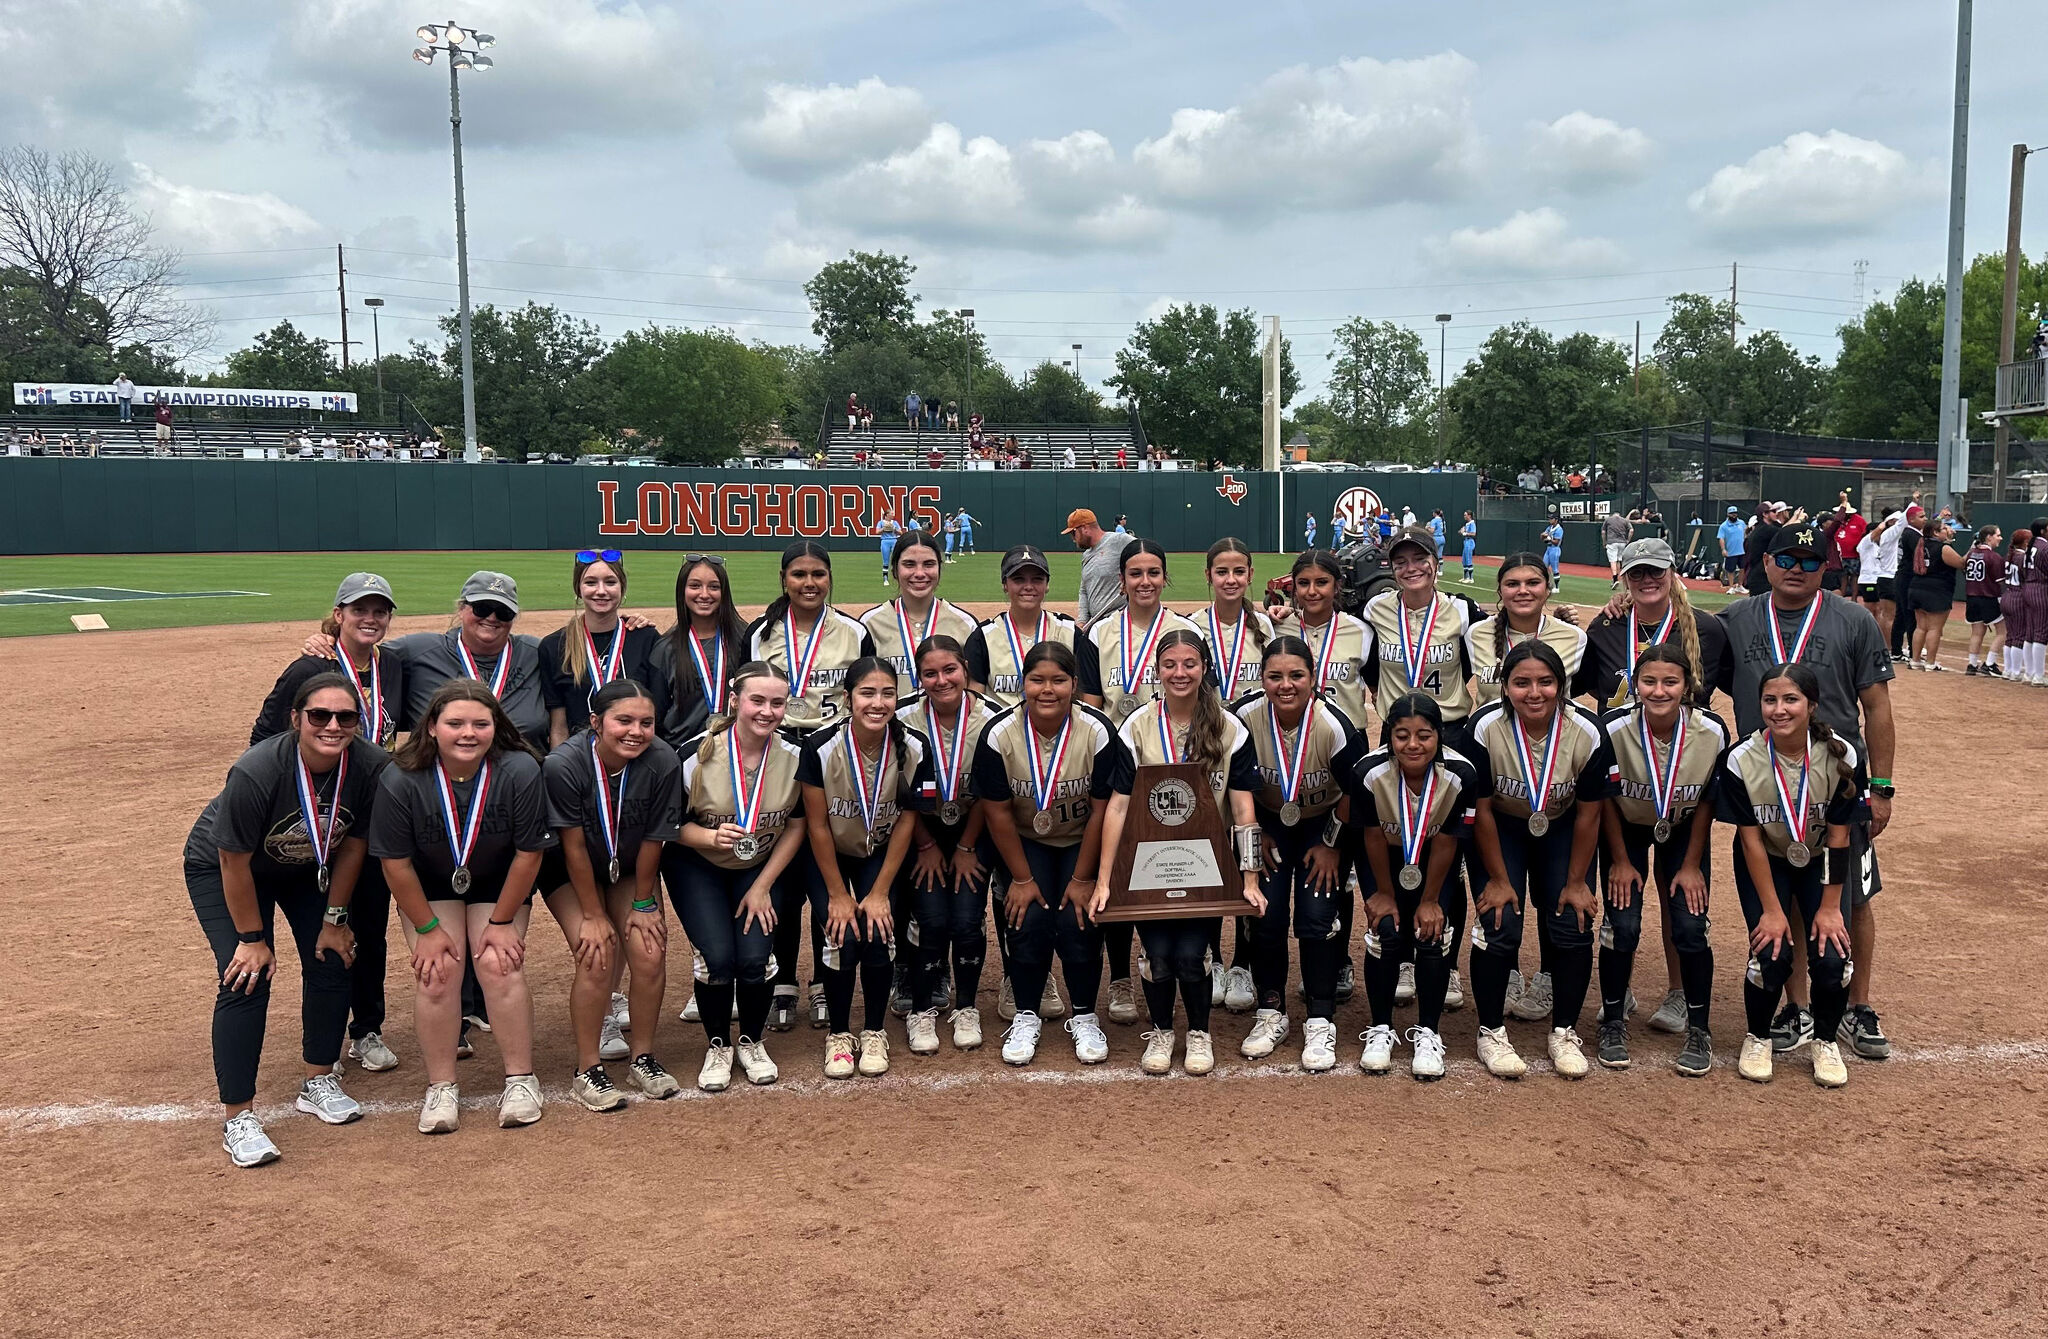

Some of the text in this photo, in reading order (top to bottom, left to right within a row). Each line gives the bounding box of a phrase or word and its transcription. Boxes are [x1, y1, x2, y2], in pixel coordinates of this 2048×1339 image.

[69, 391, 118, 404] STAT
[1227, 484, 1244, 494] 200
[598, 481, 941, 537] LONGHORNS
[1561, 504, 1582, 514] TEXAS
[1965, 558, 1985, 582] 29
[1422, 668, 1443, 697] 4
[821, 693, 839, 718] 5
[1055, 799, 1090, 824] 16
[1810, 822, 1828, 848] 7
